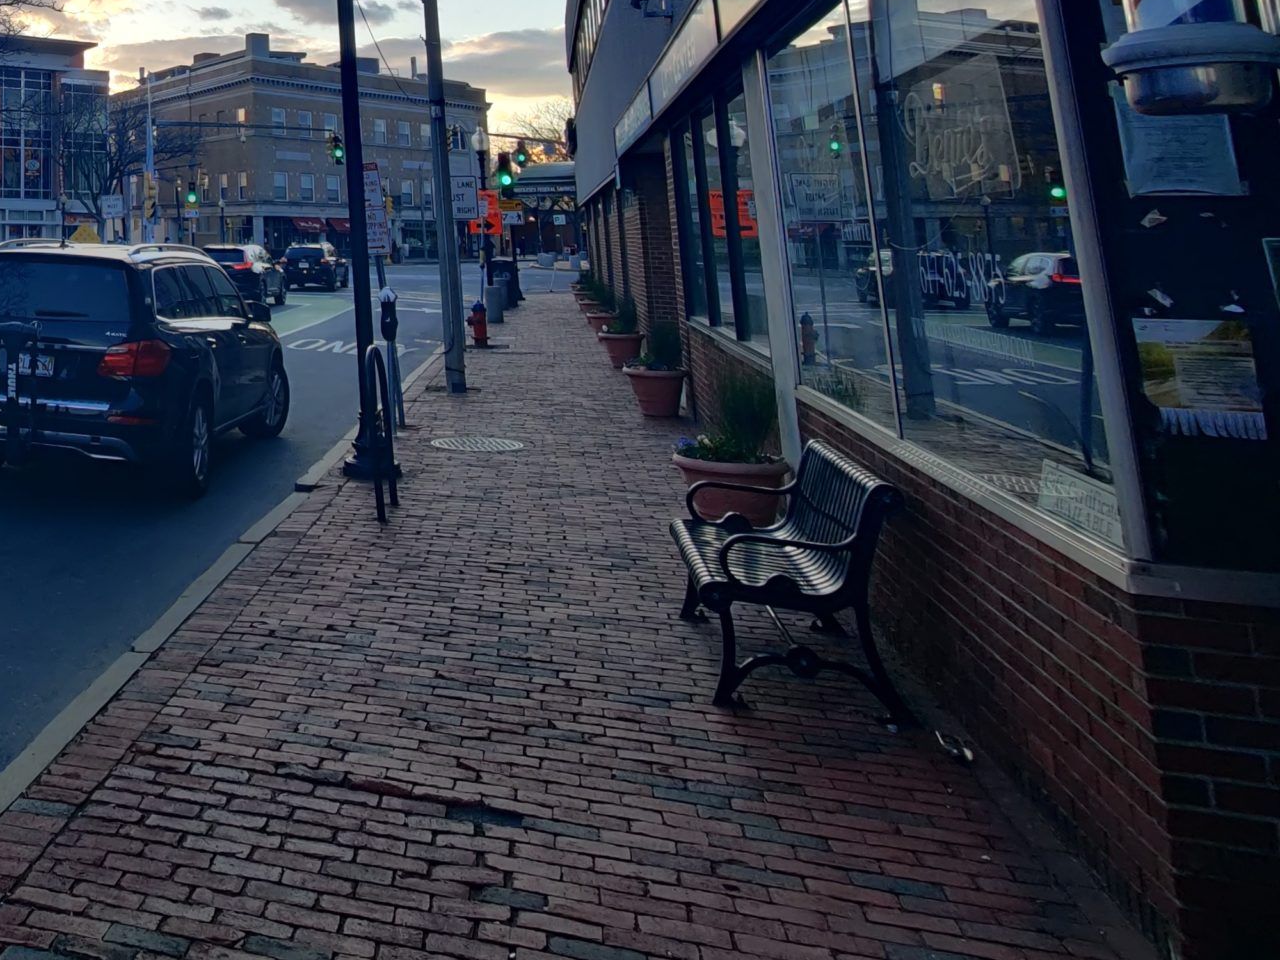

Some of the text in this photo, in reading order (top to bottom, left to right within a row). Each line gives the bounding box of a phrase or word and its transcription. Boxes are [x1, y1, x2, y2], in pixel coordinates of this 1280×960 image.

[456, 181, 475, 189] LANE
[451, 193, 465, 202] UST
[456, 206, 476, 214] RIGHT
[918, 250, 1007, 305] 617-625-8875
[7, 362, 17, 399] THULE
